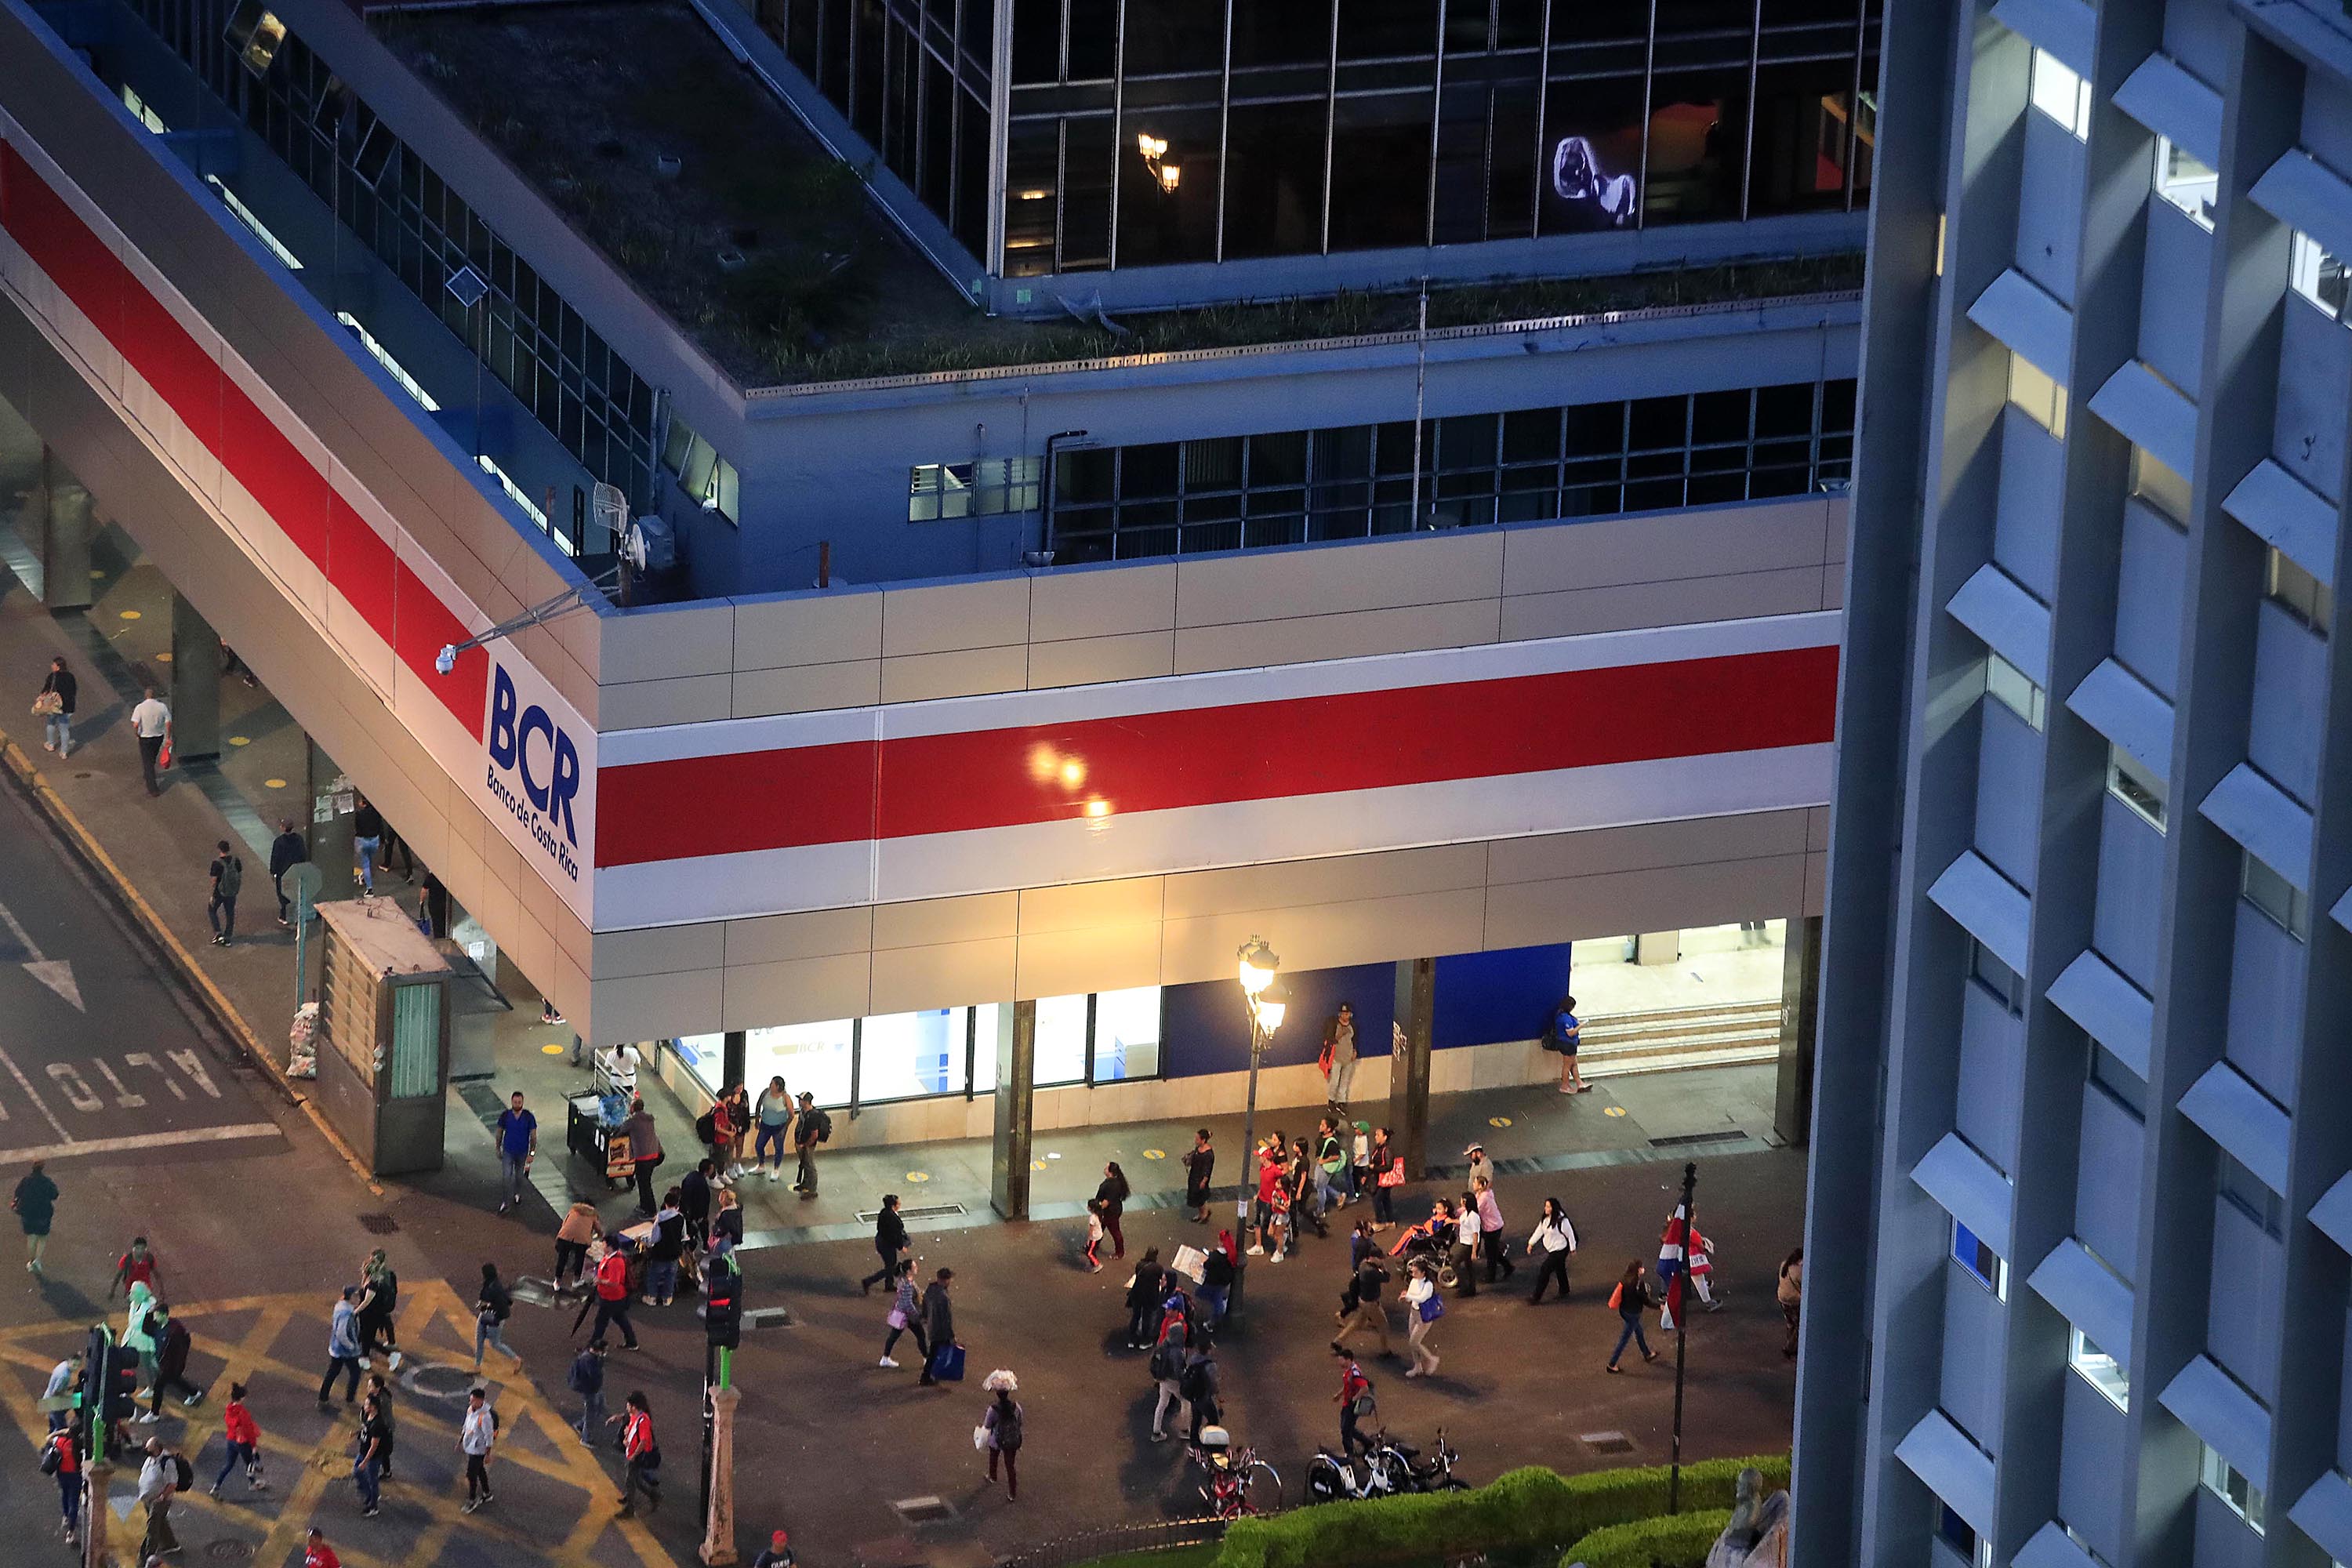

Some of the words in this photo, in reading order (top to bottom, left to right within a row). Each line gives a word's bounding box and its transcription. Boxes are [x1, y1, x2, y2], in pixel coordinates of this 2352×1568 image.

[489, 662, 579, 850] BCR
[487, 764, 516, 813] Banco
[517, 798, 529, 828] de
[531, 812, 557, 858] Costa
[558, 841, 579, 883] Rica
[45, 1048, 222, 1112] ALTO
